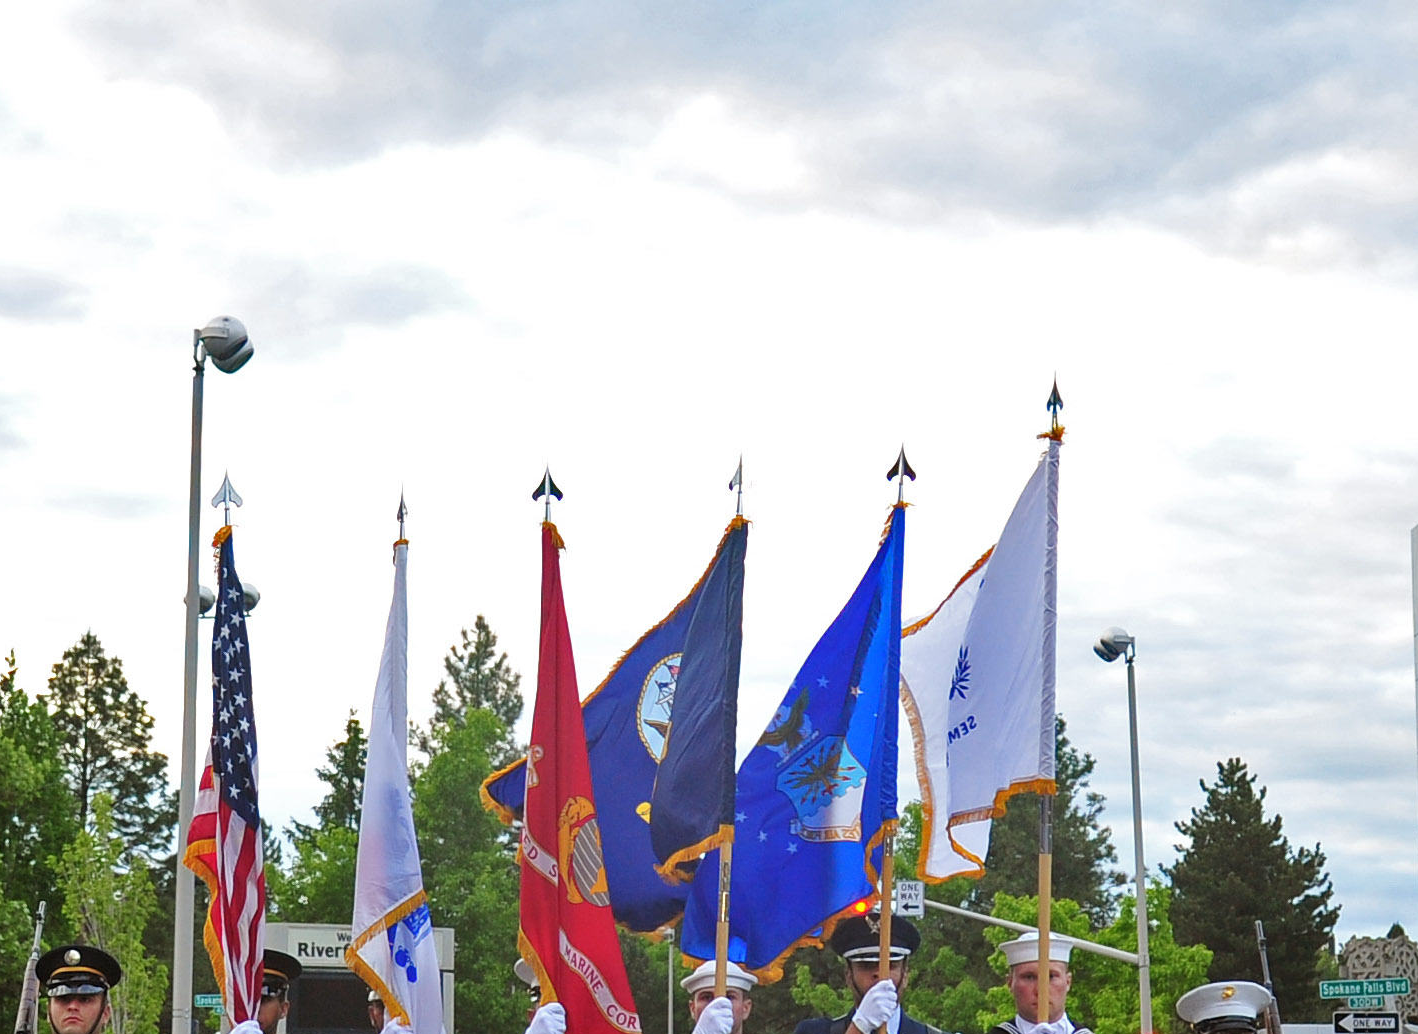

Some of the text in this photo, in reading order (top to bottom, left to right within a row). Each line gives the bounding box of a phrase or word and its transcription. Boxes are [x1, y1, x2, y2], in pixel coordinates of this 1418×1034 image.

[900, 884, 919, 892] ONE
[900, 892, 920, 901] WAY
[298, 942, 351, 958] Riverf
[564, 943, 642, 1029] MARINE COR
[1323, 980, 1406, 996] Spokane Falls Blvd
[1353, 1019, 1393, 1027] ONE WAY
